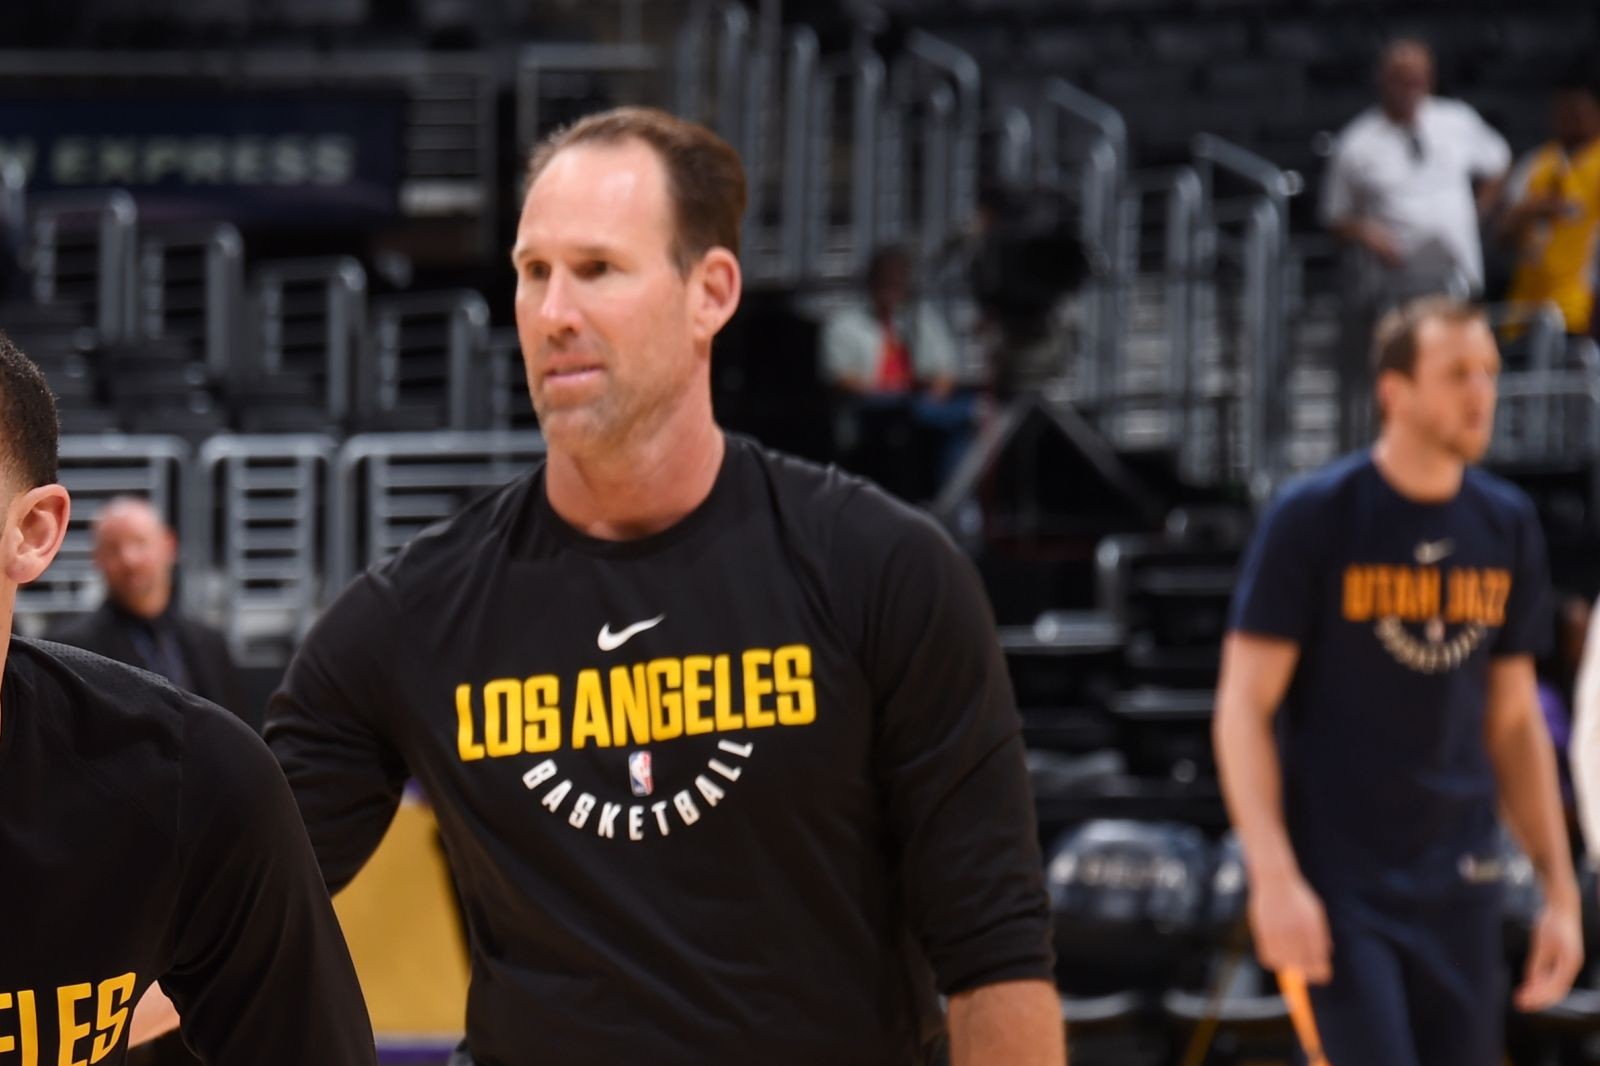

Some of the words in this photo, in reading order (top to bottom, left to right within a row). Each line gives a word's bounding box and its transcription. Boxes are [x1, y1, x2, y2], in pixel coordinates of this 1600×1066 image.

[52, 137, 353, 184] EXPRESS
[455, 674, 561, 762] LOS
[572, 644, 817, 750] ANGELES
[522, 738, 754, 841] BASKETBALL
